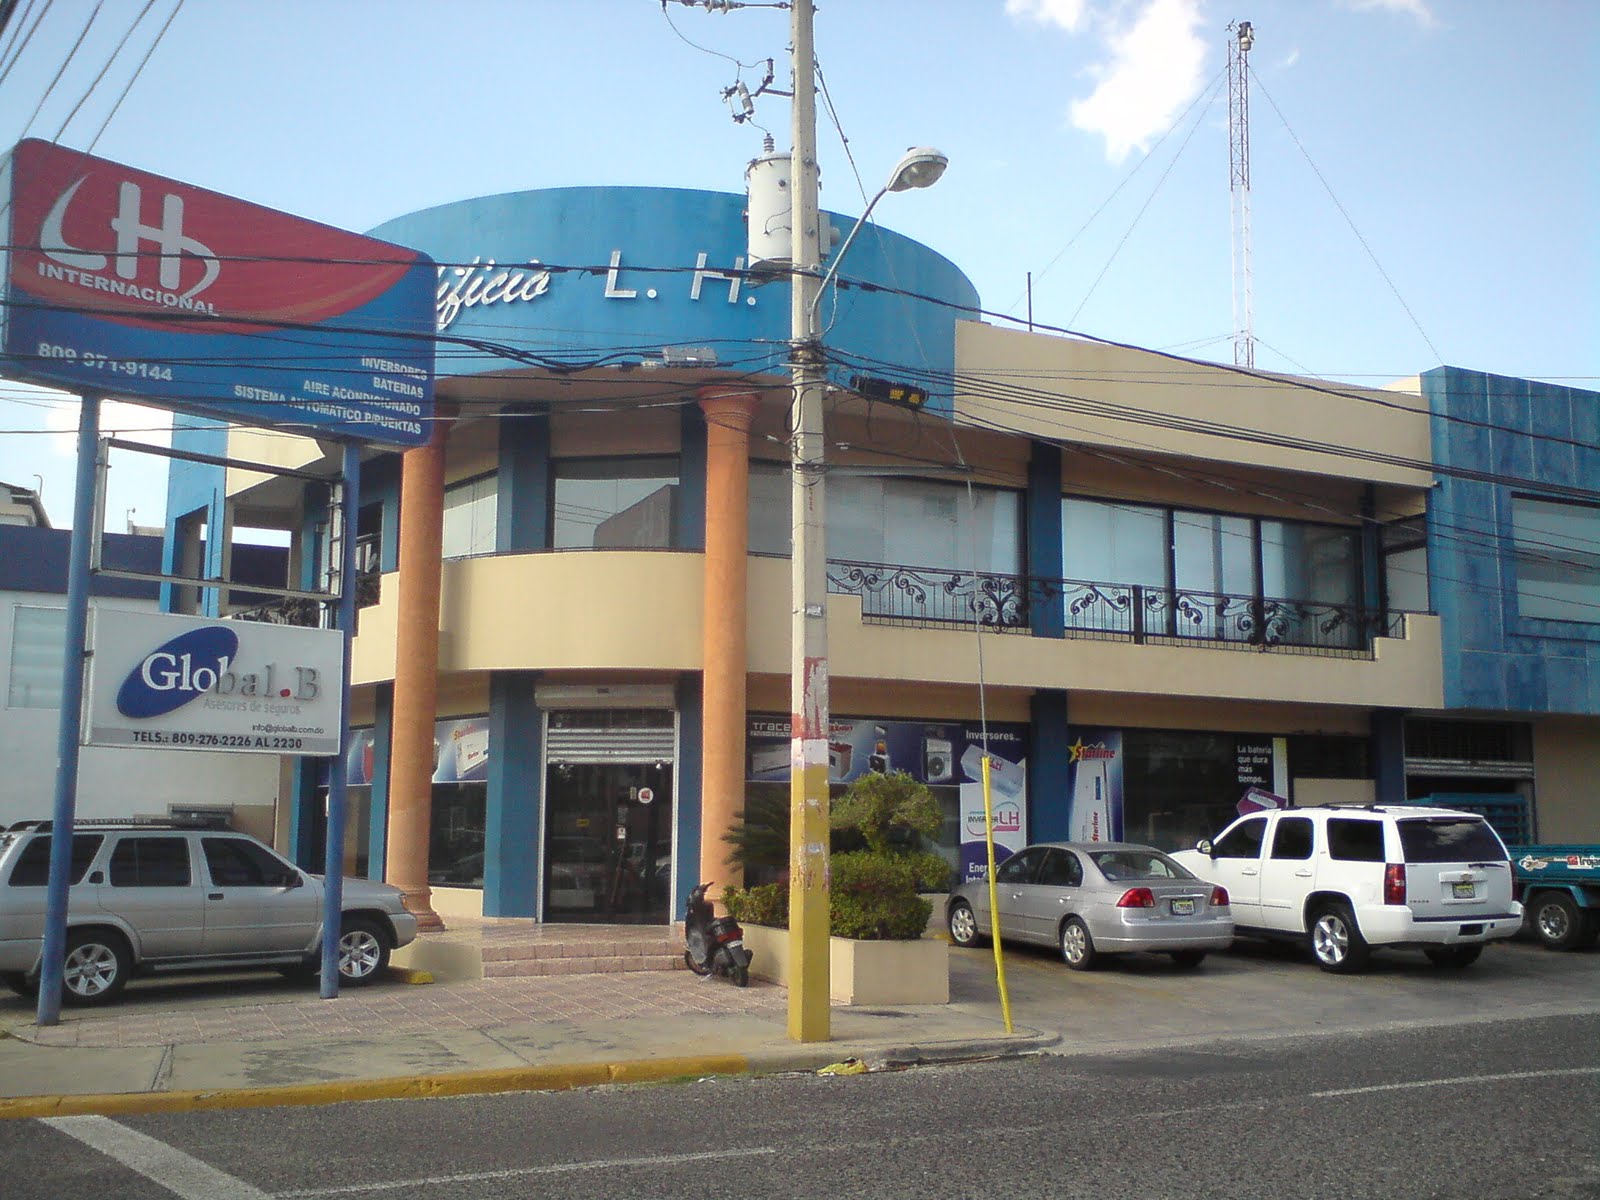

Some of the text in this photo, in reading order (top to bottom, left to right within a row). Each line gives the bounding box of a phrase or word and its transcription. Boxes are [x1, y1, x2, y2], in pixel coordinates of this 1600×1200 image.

[38, 262, 220, 317] INTERNACIONAL
[604, 250, 658, 299] L.
[690, 252, 757, 306] H.
[361, 355, 428, 381] INVERSORES
[234, 384, 286, 407] SISTEMA
[303, 380, 330, 397] AIRE
[373, 376, 424, 399] BATERIAS
[172, 733, 251, 746] 809-276-2226
[254, 737, 270, 747] AL
[273, 738, 303, 749] 2230
